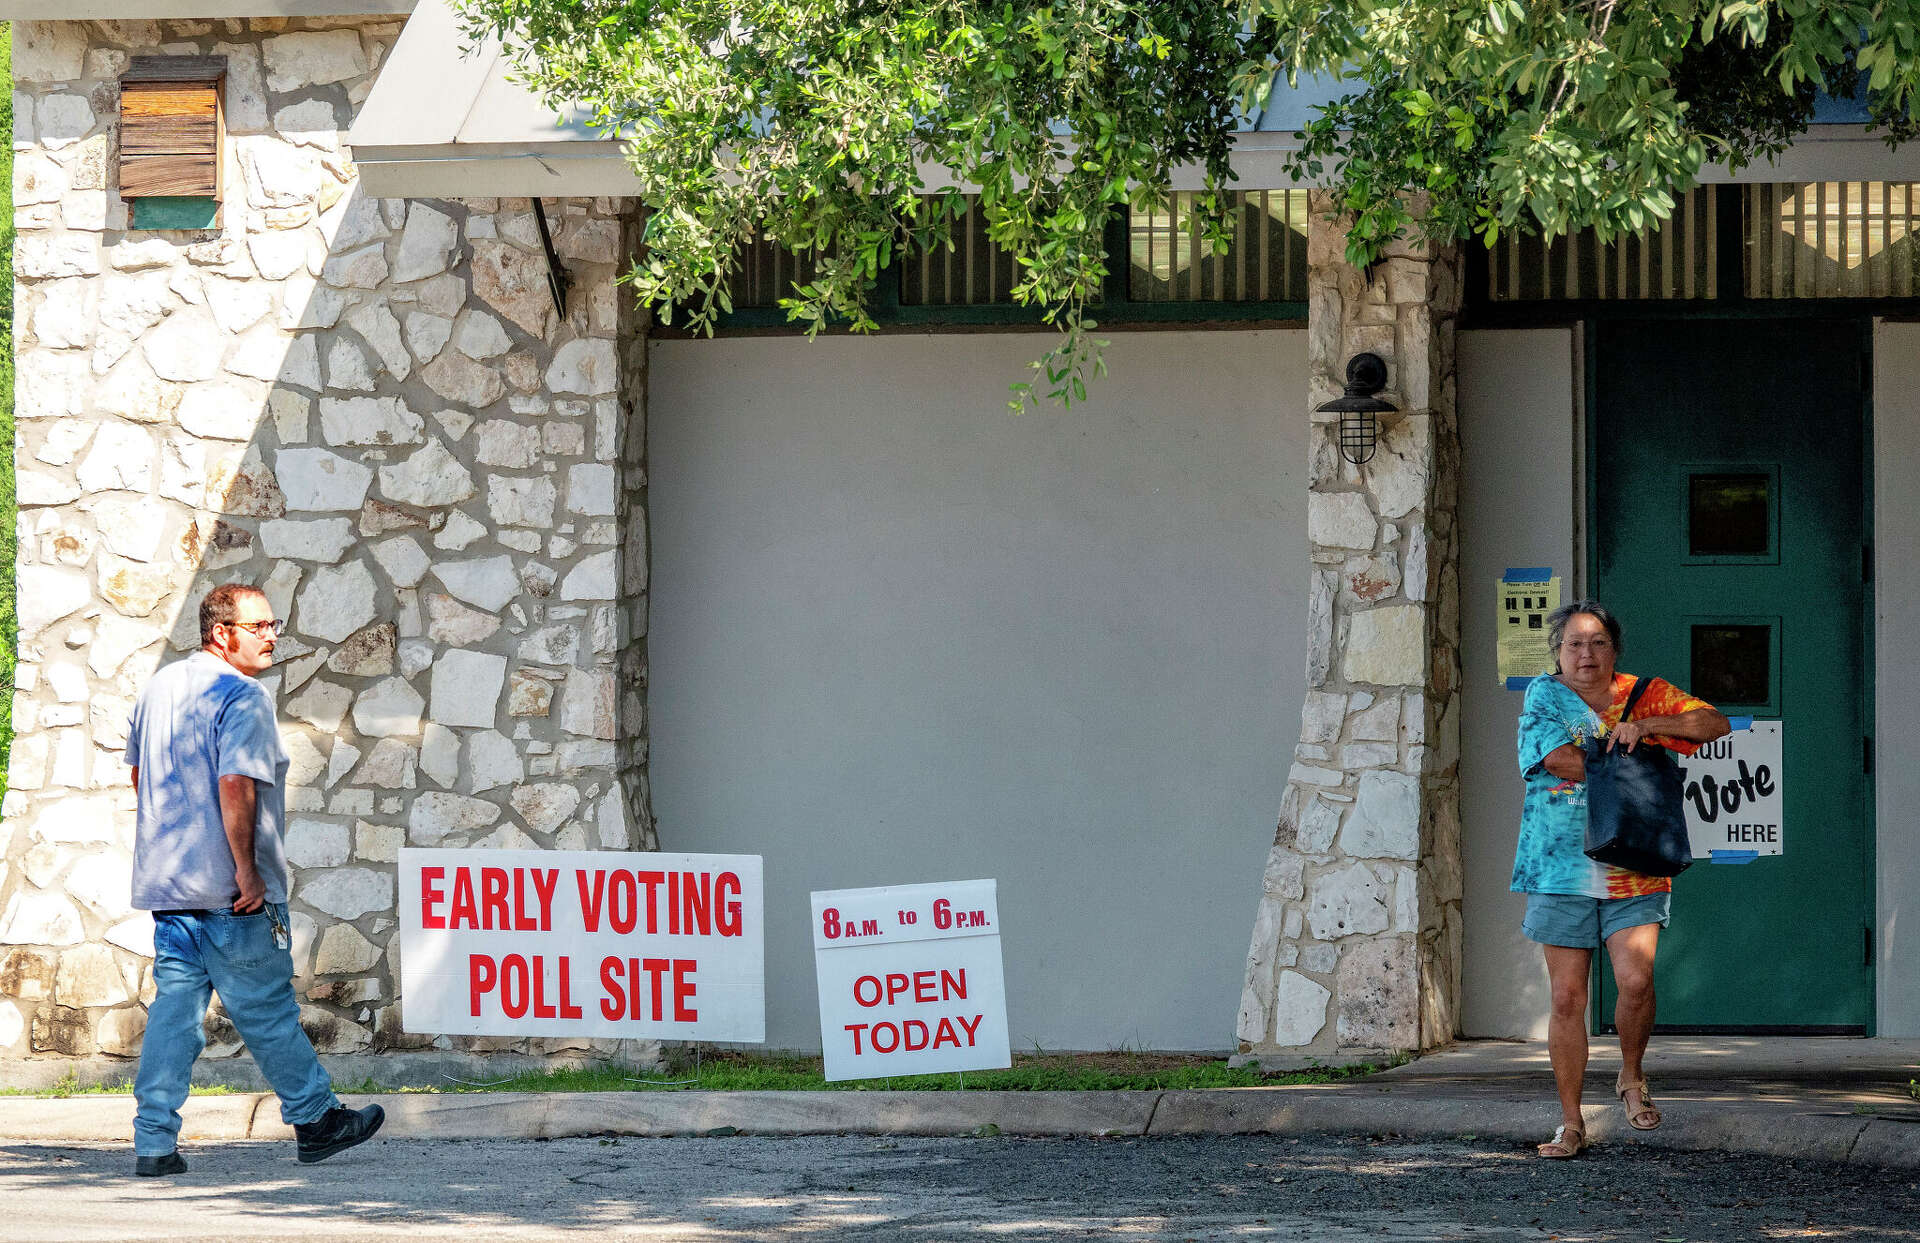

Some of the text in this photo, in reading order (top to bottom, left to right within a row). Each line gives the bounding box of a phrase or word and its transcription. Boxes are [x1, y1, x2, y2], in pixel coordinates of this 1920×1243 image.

[1685, 759, 1775, 824] Vote
[1727, 824, 1777, 843] HERE
[420, 866, 743, 937] EARLY VOTING
[898, 910, 917, 925] to
[469, 953, 698, 1023] POLL SITE
[853, 968, 968, 1008] OPEN
[844, 1014, 983, 1056] TODAY
